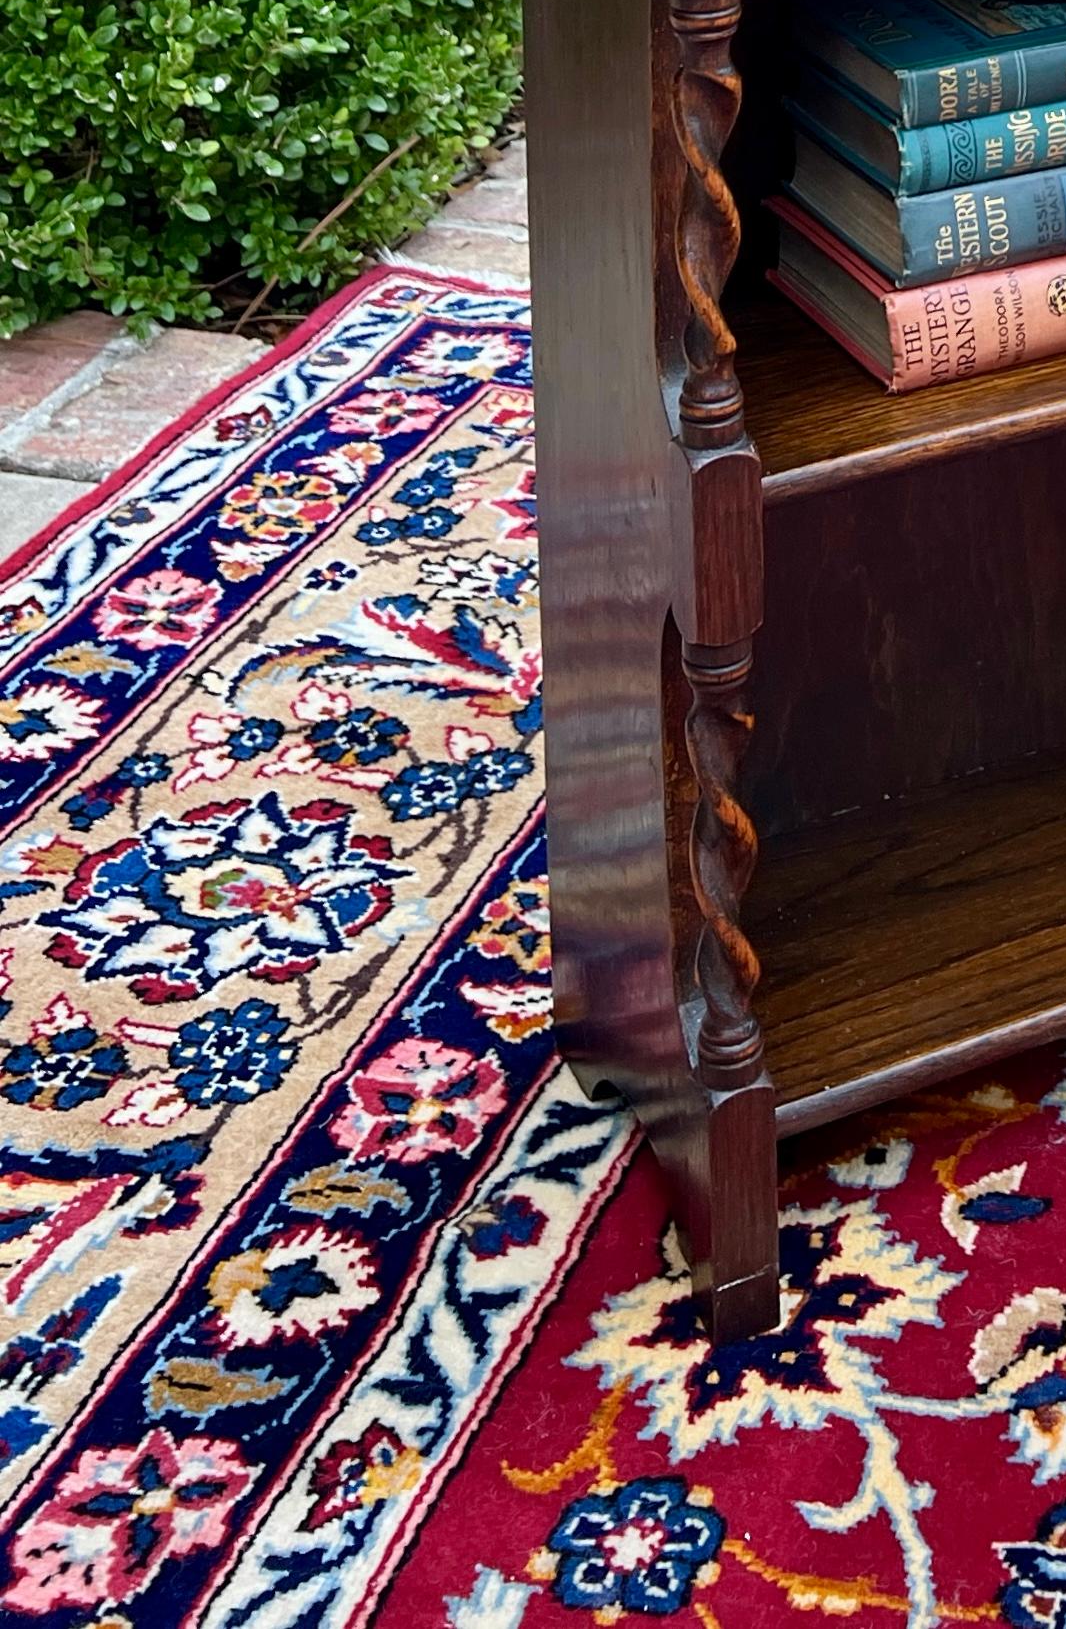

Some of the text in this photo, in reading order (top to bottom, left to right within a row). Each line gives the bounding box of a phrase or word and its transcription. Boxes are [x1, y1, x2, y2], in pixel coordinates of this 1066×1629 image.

[938, 66, 960, 121] DORA
[966, 68, 979, 114] A TALE
[980, 82, 990, 98] OF
[984, 136, 1004, 172] THE
[934, 224, 955, 266] The
[983, 195, 1011, 267] SCOUT
[1007, 268, 1025, 320] WILSON
[902, 321, 924, 370] THE
[923, 287, 951, 387] MYSTERY
[950, 283, 977, 377] GRANGE
[992, 286, 1009, 360] THEODORA
